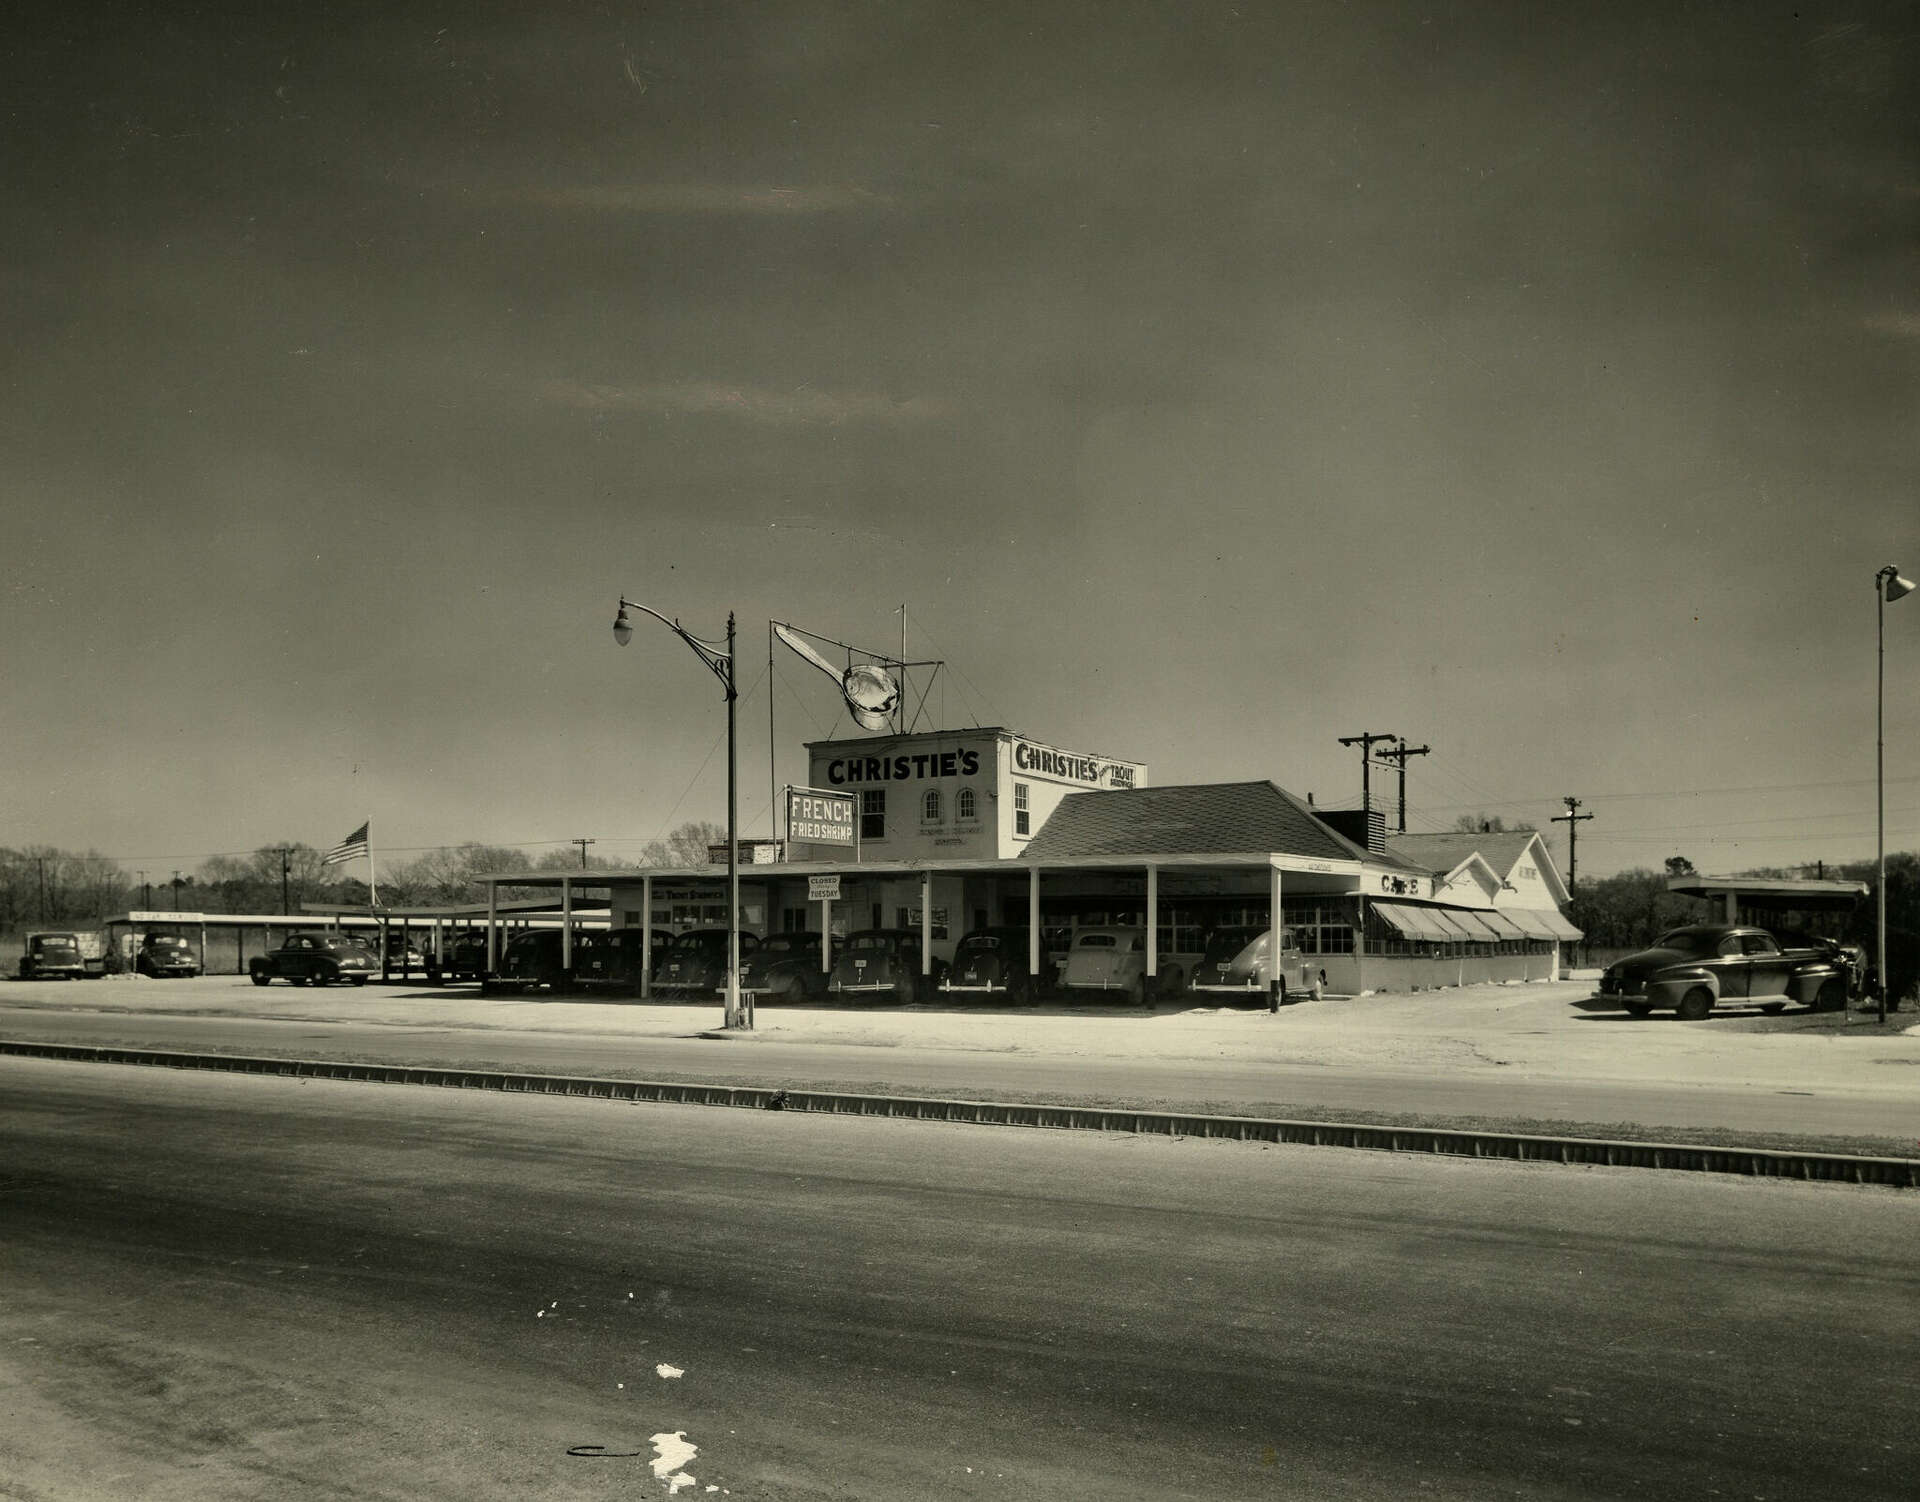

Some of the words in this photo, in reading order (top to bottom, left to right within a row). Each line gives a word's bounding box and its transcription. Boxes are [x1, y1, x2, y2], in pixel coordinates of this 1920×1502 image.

[828, 748, 979, 785] CHRISTIE'S
[1015, 743, 1098, 782] CHRISTIE'S
[1110, 765, 1134, 782] TROUT
[791, 796, 852, 823] FRENCH
[791, 821, 820, 838] FRIED
[821, 824, 852, 841] SHRIMP
[810, 877, 837, 885] CLOSED
[810, 889, 838, 898] TUESDAY
